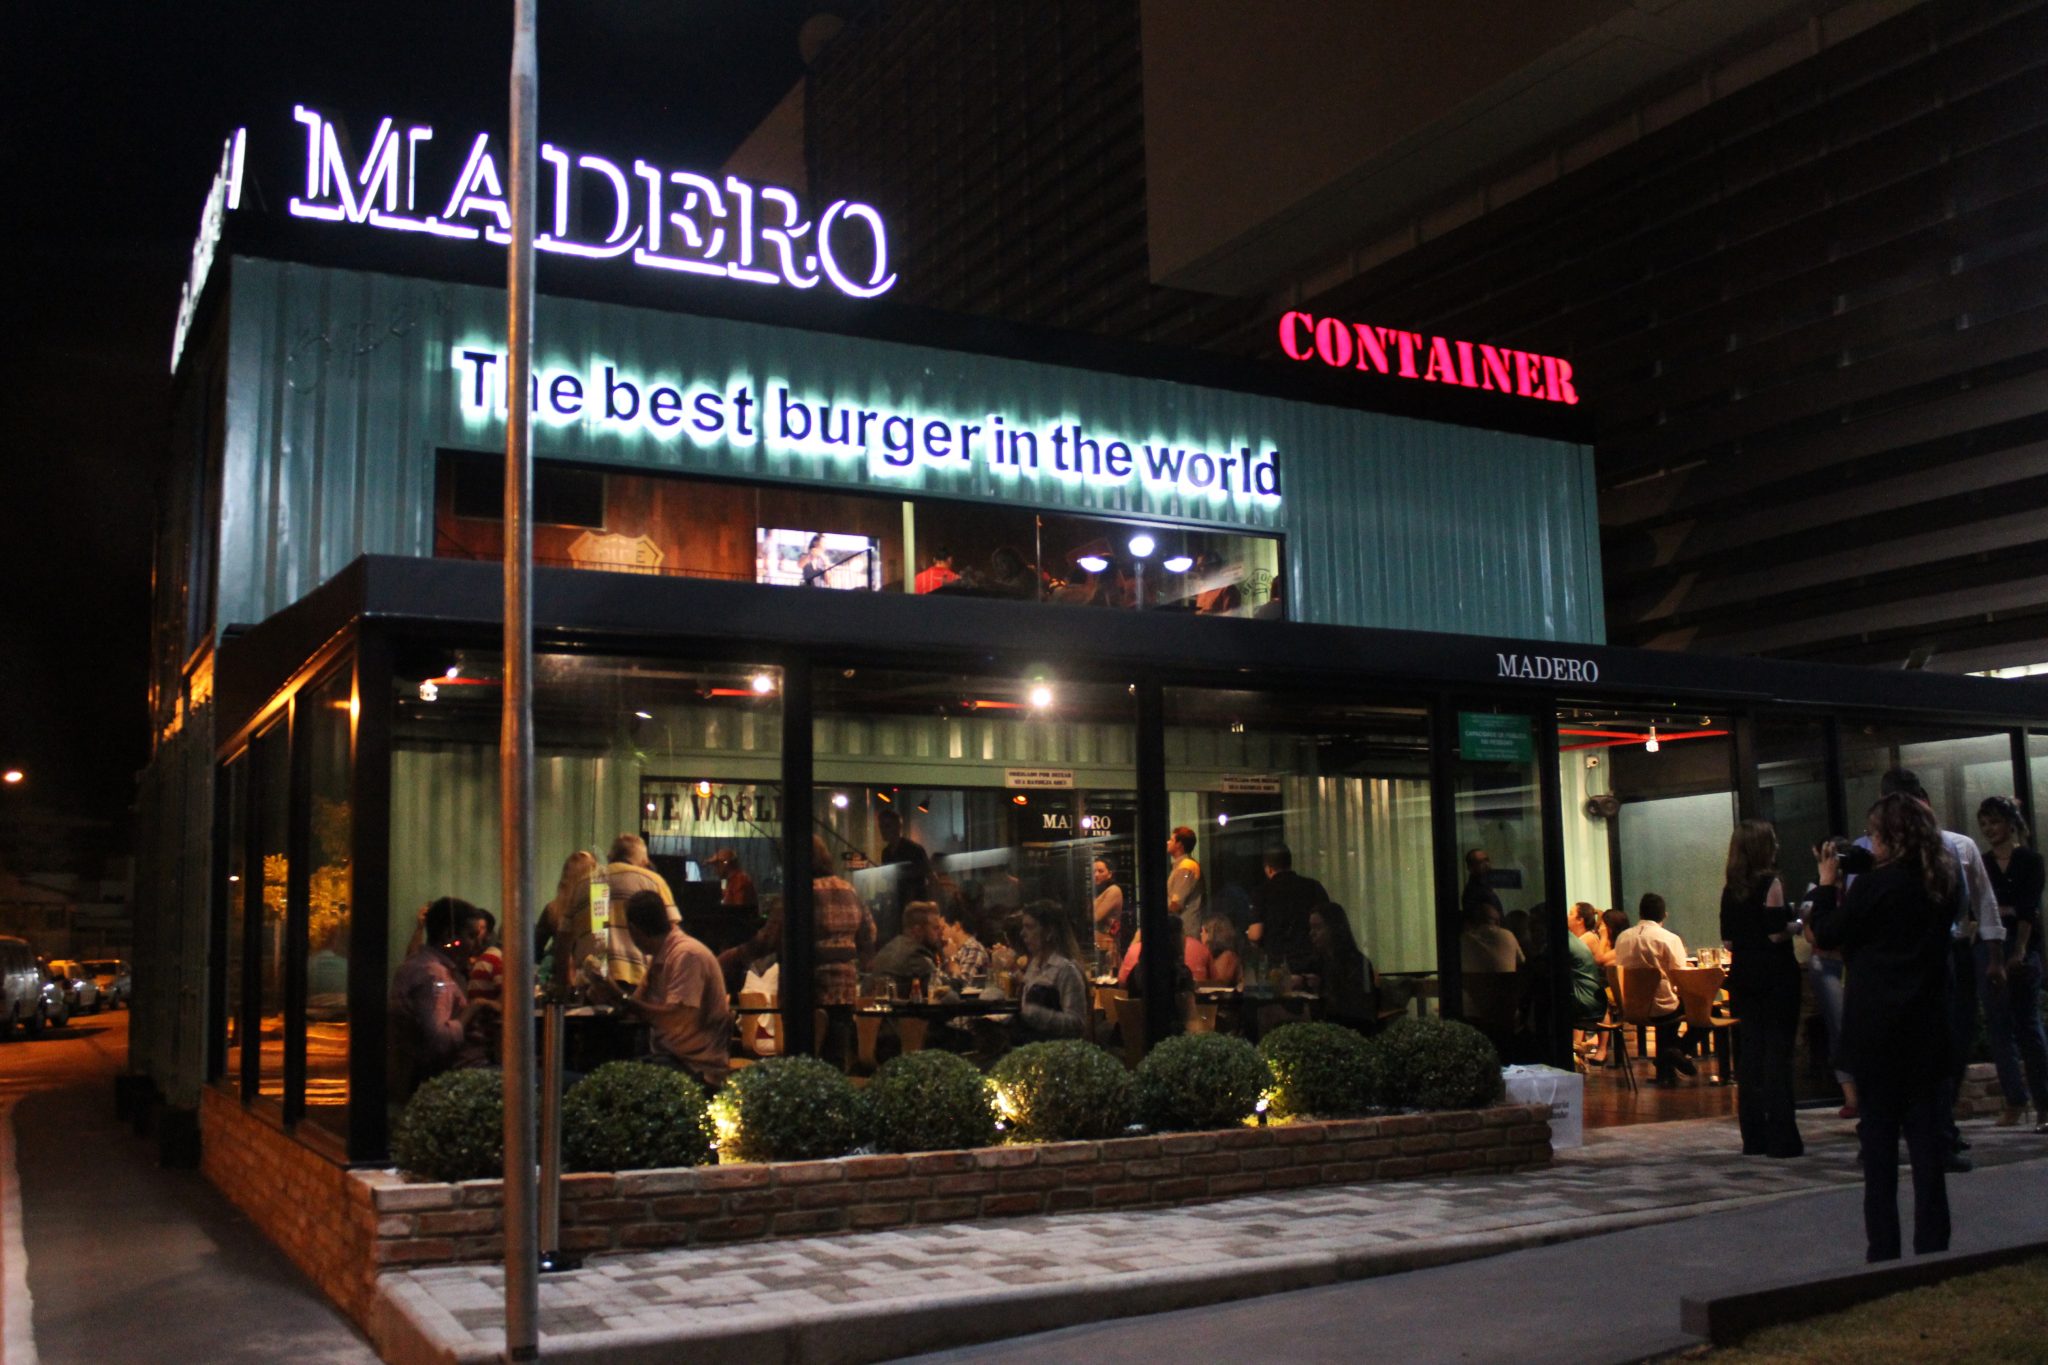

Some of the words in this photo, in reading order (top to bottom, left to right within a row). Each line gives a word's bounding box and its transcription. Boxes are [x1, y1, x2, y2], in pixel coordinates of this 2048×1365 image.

[290, 105, 897, 298] MADERO
[1279, 311, 1579, 405] CONTAINER
[463, 351, 583, 414] Te
[605, 366, 753, 435] best
[779, 387, 981, 467] burger
[994, 416, 1038, 468] in
[1050, 425, 1132, 477] the
[1142, 445, 1282, 497] world
[1496, 653, 1599, 683] MADERO
[690, 793, 783, 822] WORL
[1042, 814, 1112, 830] MARO
